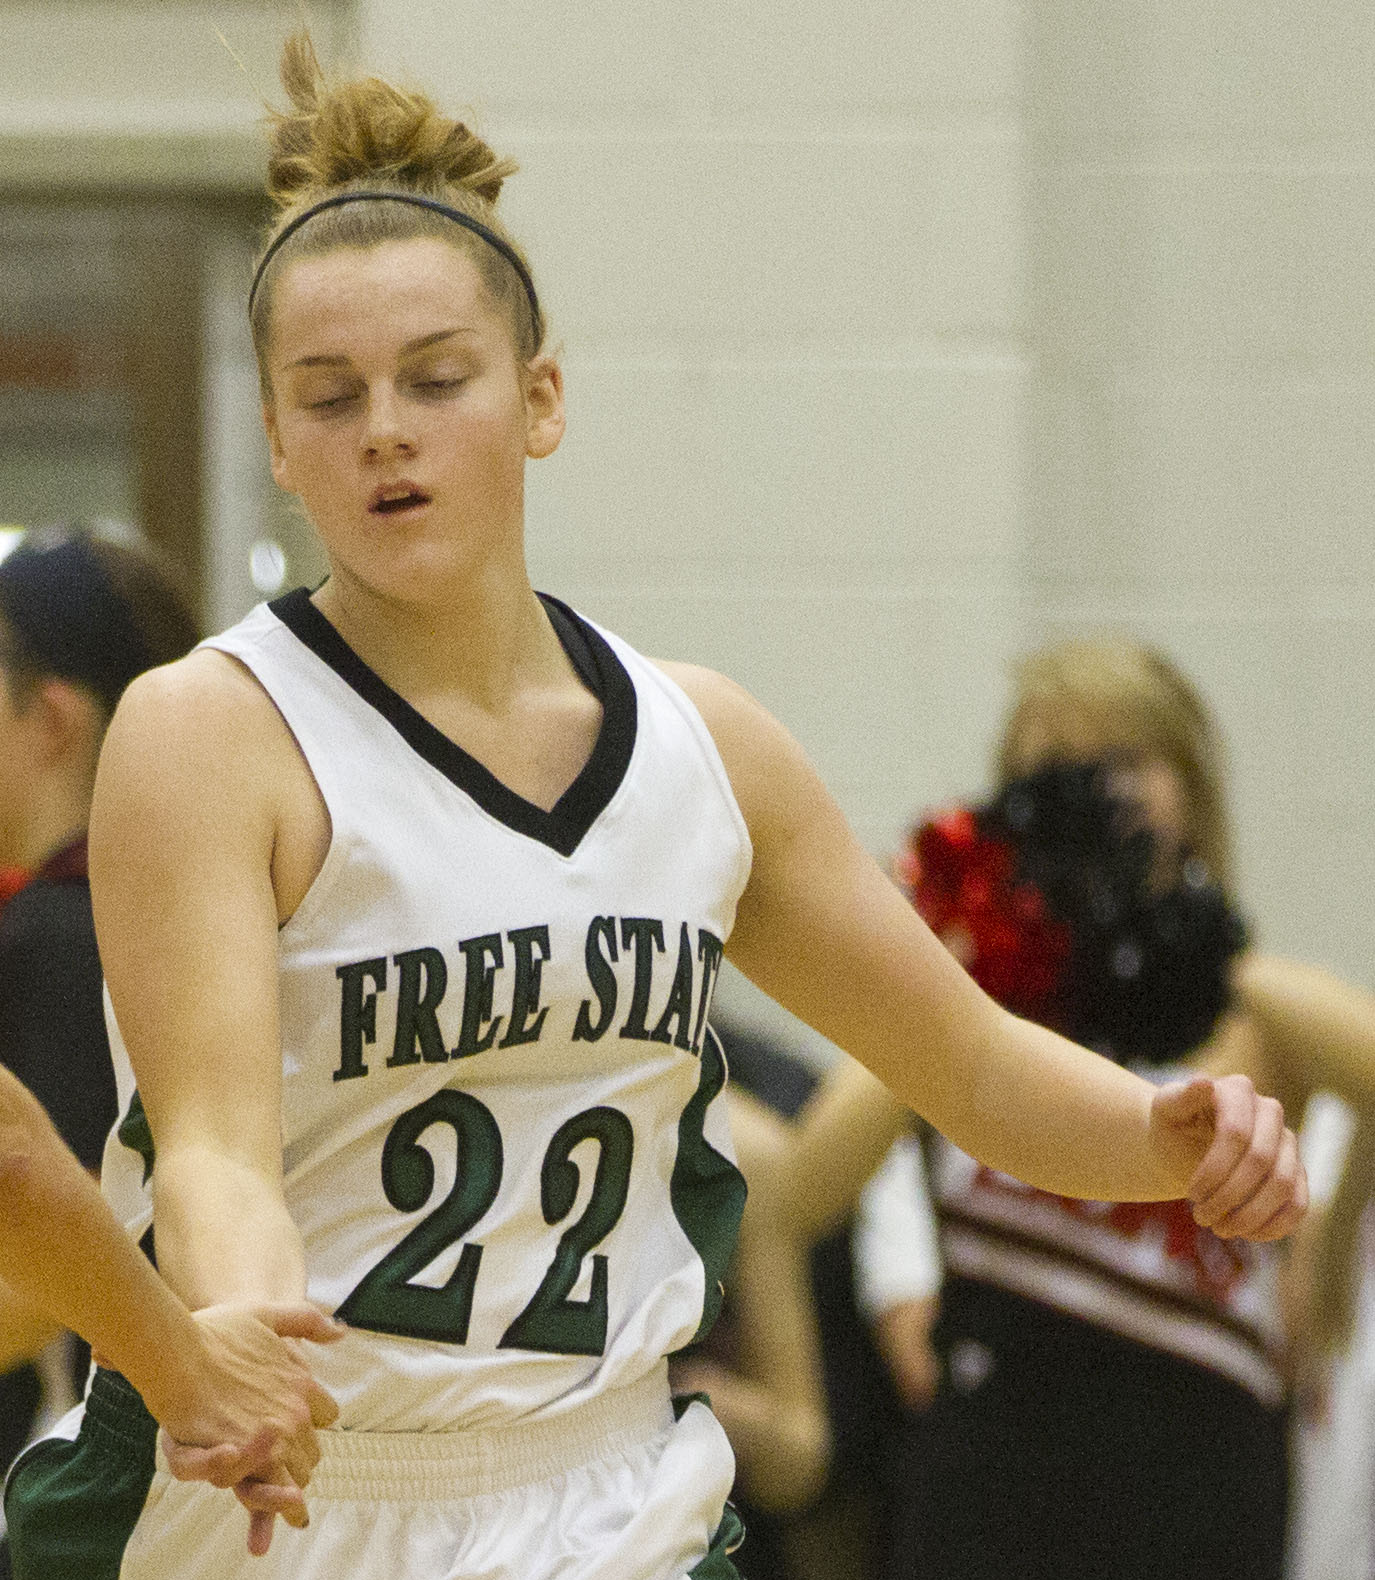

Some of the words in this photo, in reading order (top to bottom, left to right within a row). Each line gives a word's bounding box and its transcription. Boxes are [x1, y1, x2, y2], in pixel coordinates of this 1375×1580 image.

[333, 924, 551, 1082] FREE
[571, 915, 724, 1058] STAT
[332, 1088, 634, 1357] 22
